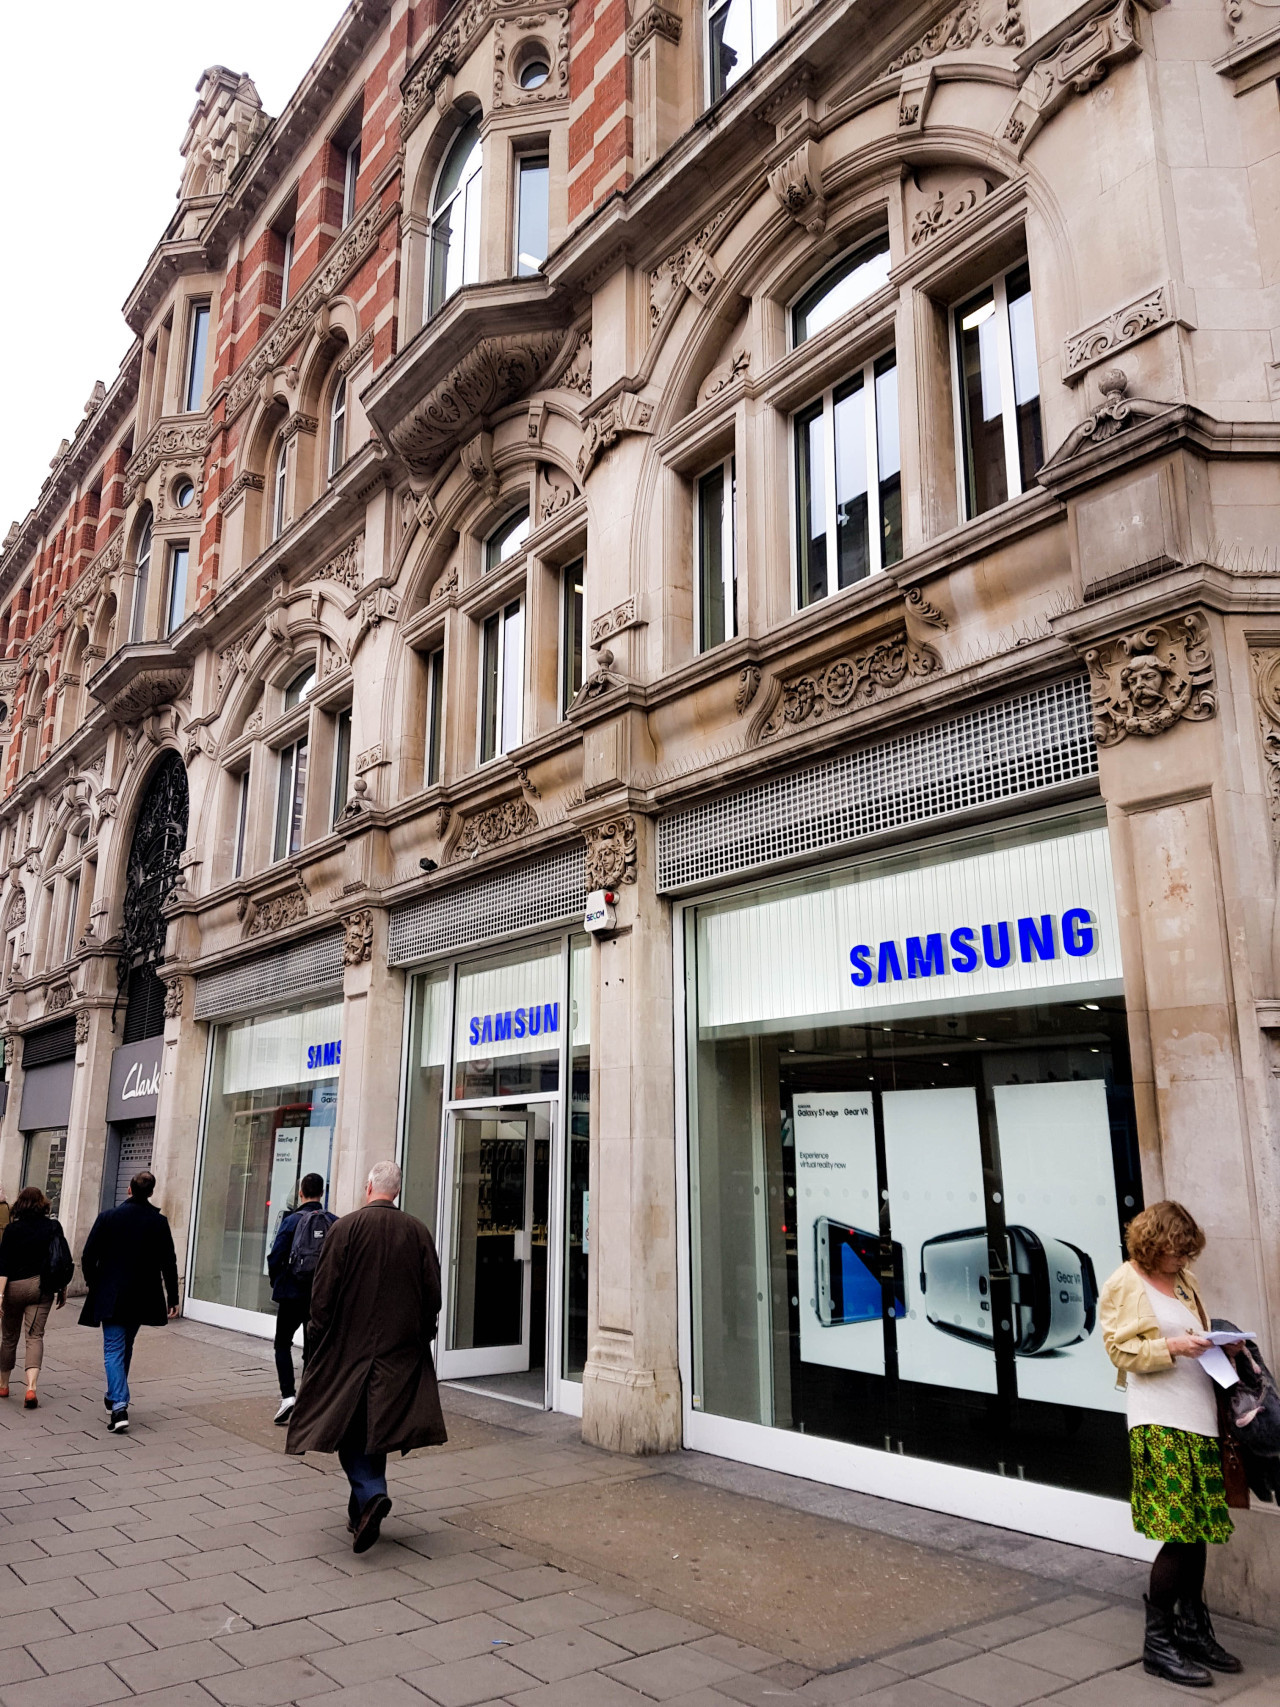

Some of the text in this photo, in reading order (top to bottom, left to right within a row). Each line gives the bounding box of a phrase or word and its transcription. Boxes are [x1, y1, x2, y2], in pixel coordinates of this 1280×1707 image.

[586, 909, 605, 922] SECOM
[850, 908, 1096, 987] SAMSUNG
[469, 1002, 560, 1046] SAMSUN
[797, 1107, 868, 1118] Galaxy S7 edge Gear VR
[799, 1152, 829, 1160] Experience
[800, 1161, 816, 1169] virtual
[817, 1161, 833, 1170] reality
[1057, 1271, 1073, 1284] Gear
